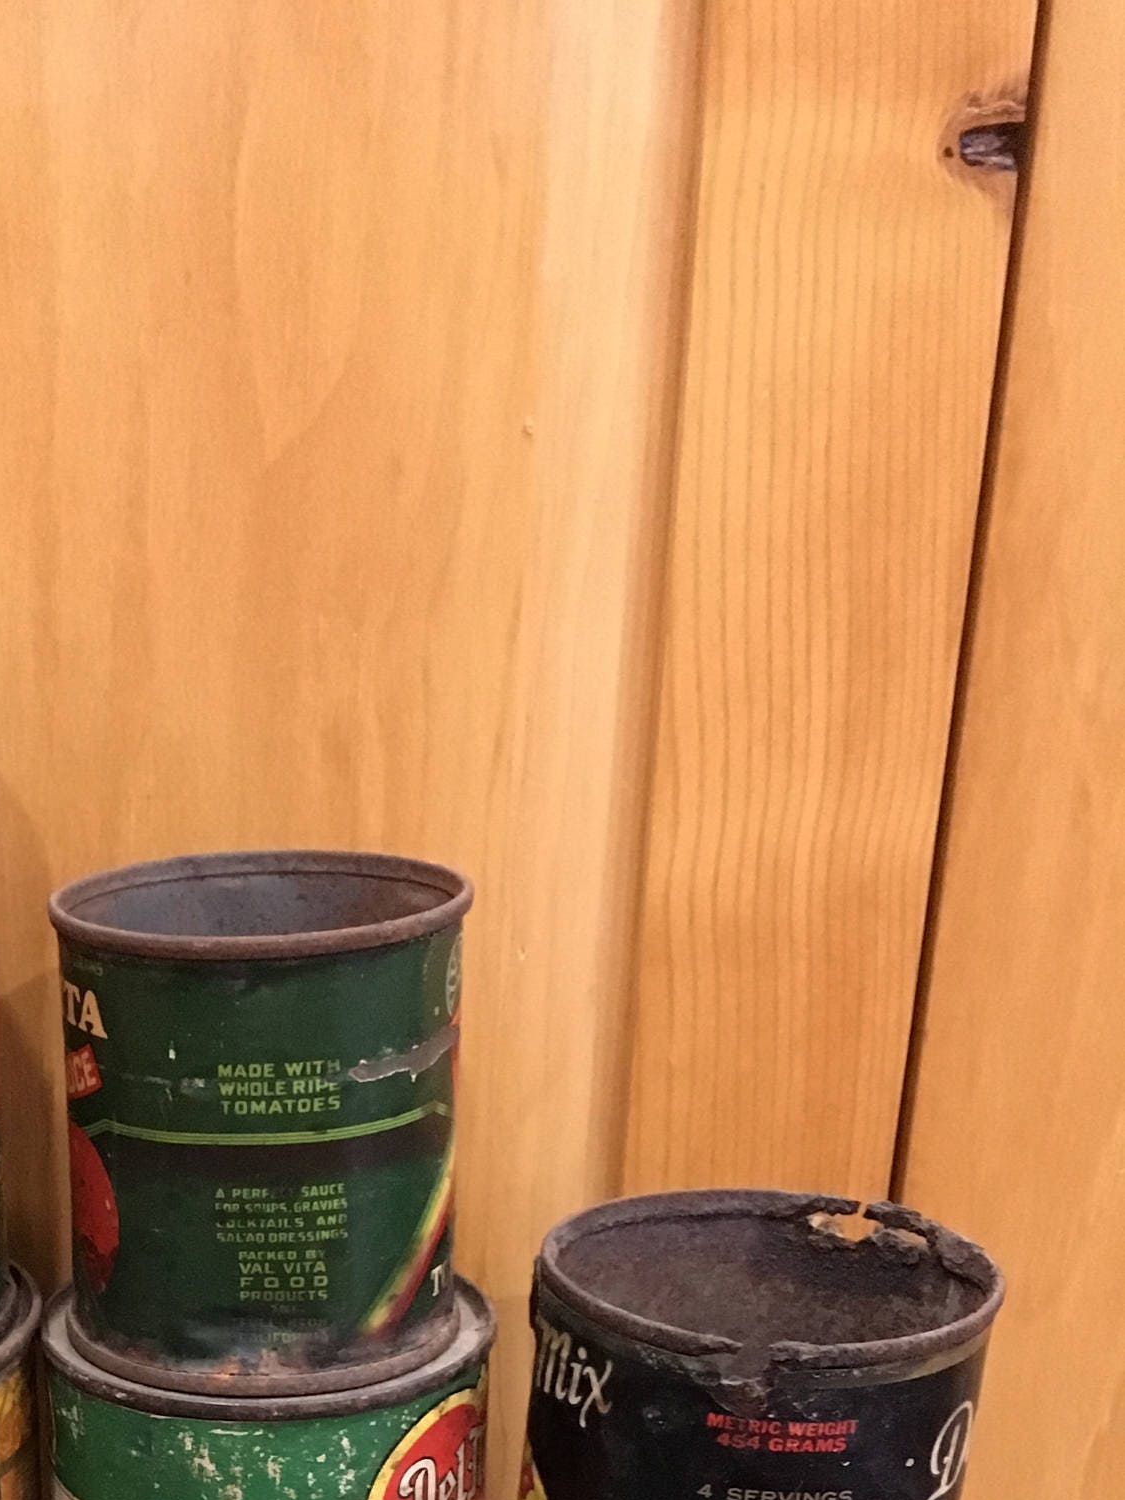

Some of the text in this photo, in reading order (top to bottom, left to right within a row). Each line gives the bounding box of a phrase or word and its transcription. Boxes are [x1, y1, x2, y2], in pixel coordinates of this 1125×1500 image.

[217, 1059, 341, 1078] MADE WITH
[218, 1078, 340, 1097] WHOLE RIPE
[220, 1094, 341, 1115] TOMATOES
[215, 1183, 345, 1199] A SAUCE
[215, 1202, 240, 1213] FOR
[293, 1198, 348, 1213] GRAVIES
[316, 1213, 348, 1227] AND
[216, 1227, 349, 1244] SALAD DRESSINGS
[238, 1249, 326, 1261] PACKED BY
[238, 1261, 327, 1274] VAL VITA
[239, 1275, 329, 1289] FOOD
[239, 1289, 329, 1301] PRODUCTS
[535, 1312, 614, 1429] Mix
[706, 1411, 859, 1437] METRIC WEIGHT
[717, 1432, 848, 1453] 454 GRAMS
[695, 1483, 713, 1499] 4
